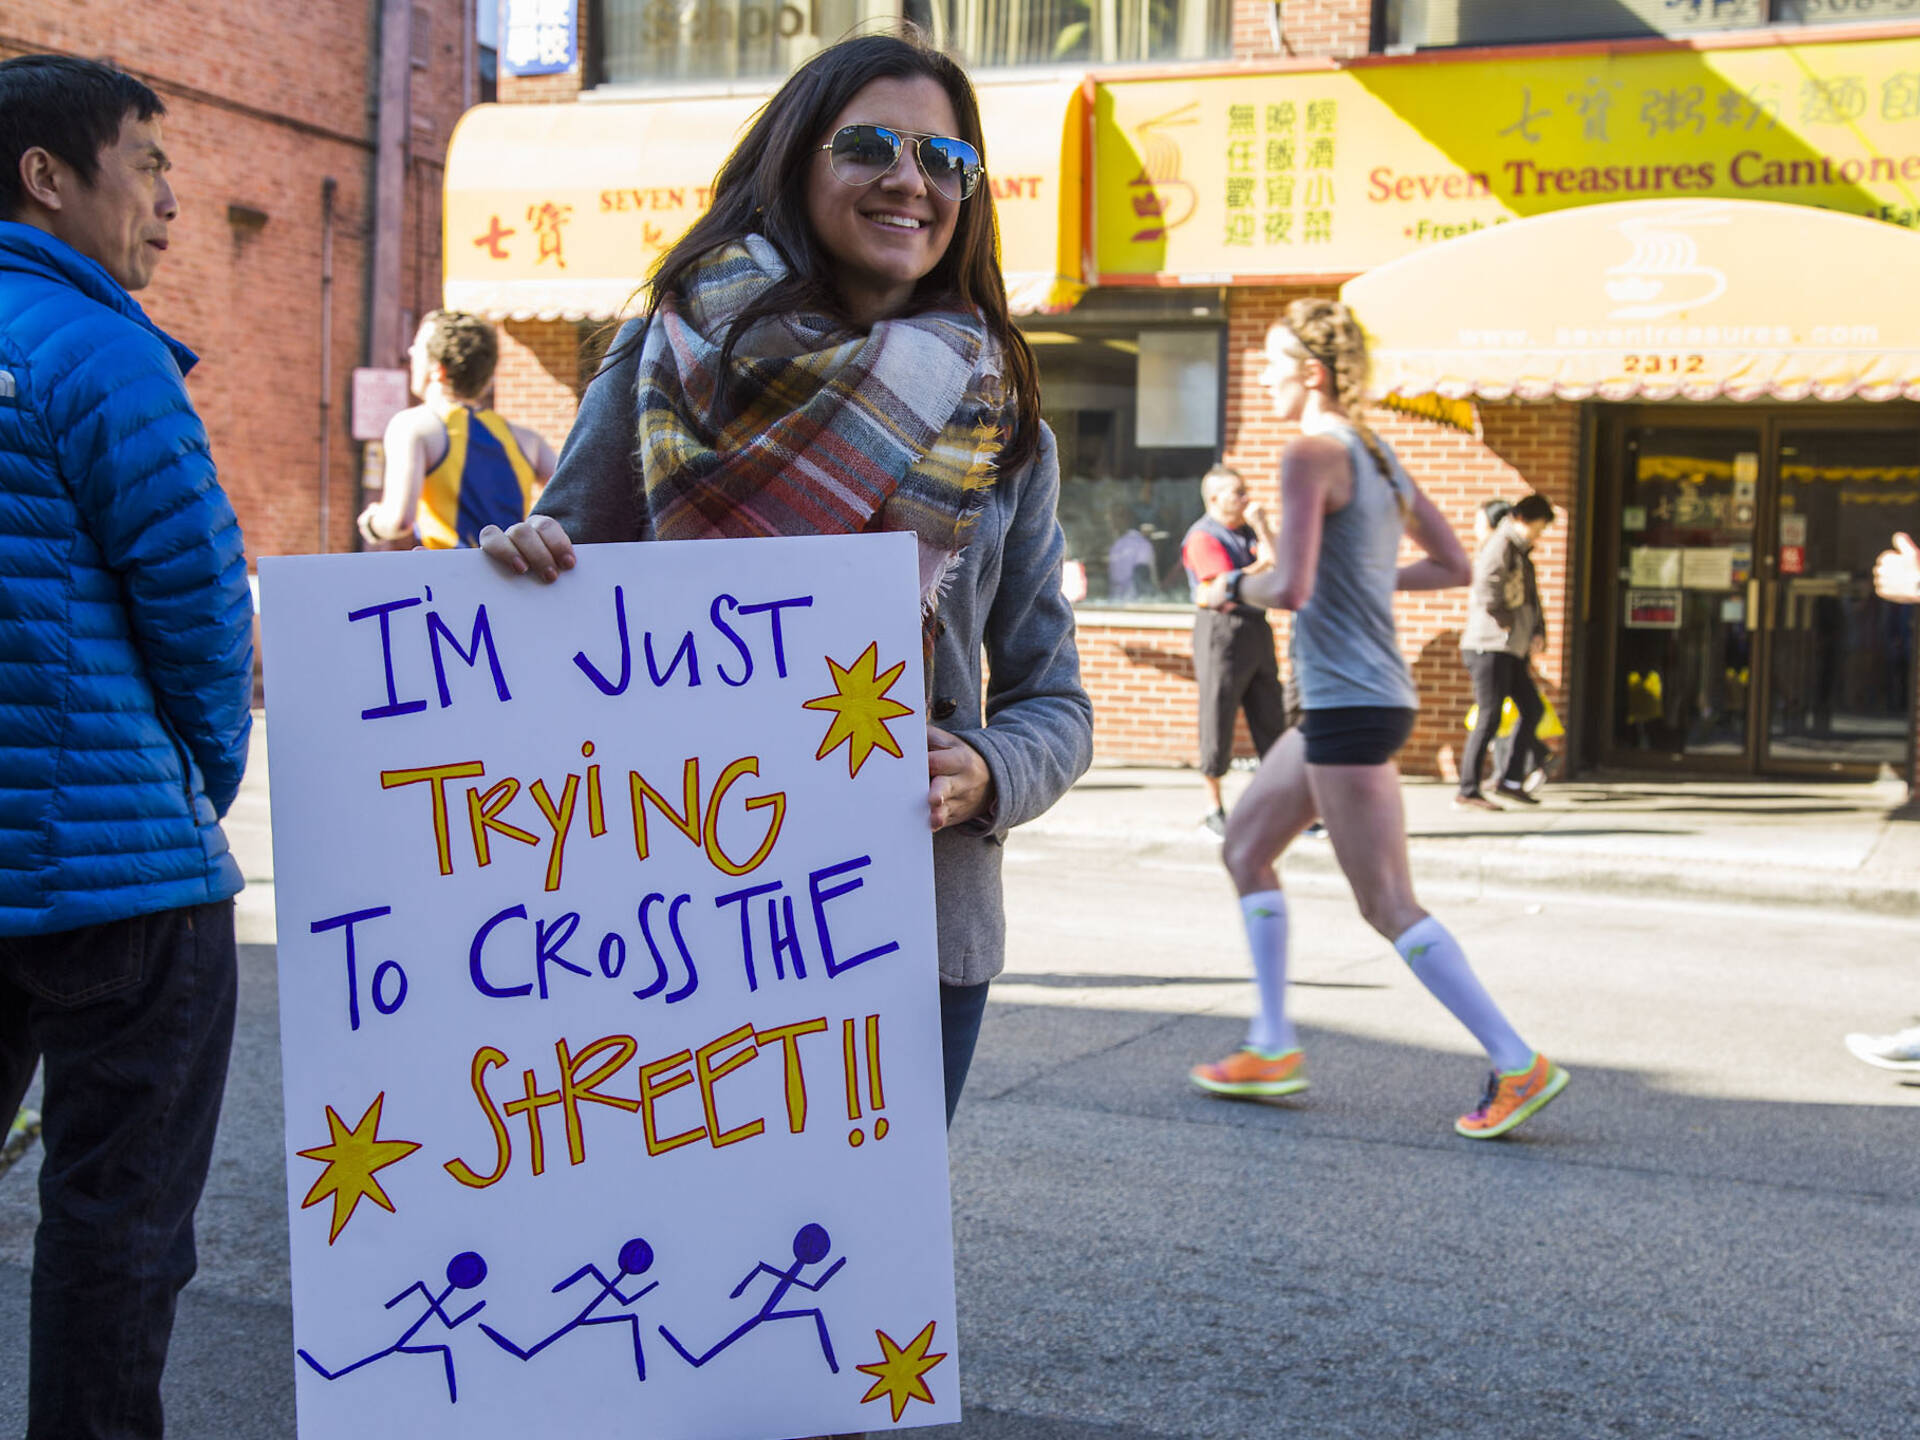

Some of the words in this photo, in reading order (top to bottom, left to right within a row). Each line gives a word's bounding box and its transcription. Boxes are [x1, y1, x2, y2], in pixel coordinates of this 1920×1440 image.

[600, 187, 685, 212] SEVEN
[1368, 166, 1491, 203] Seven
[1504, 159, 1716, 196] Treasures
[473, 203, 573, 270] 七寶
[1623, 354, 1706, 374] 2312
[347, 585, 513, 721] I'M
[715, 854, 900, 993] THE
